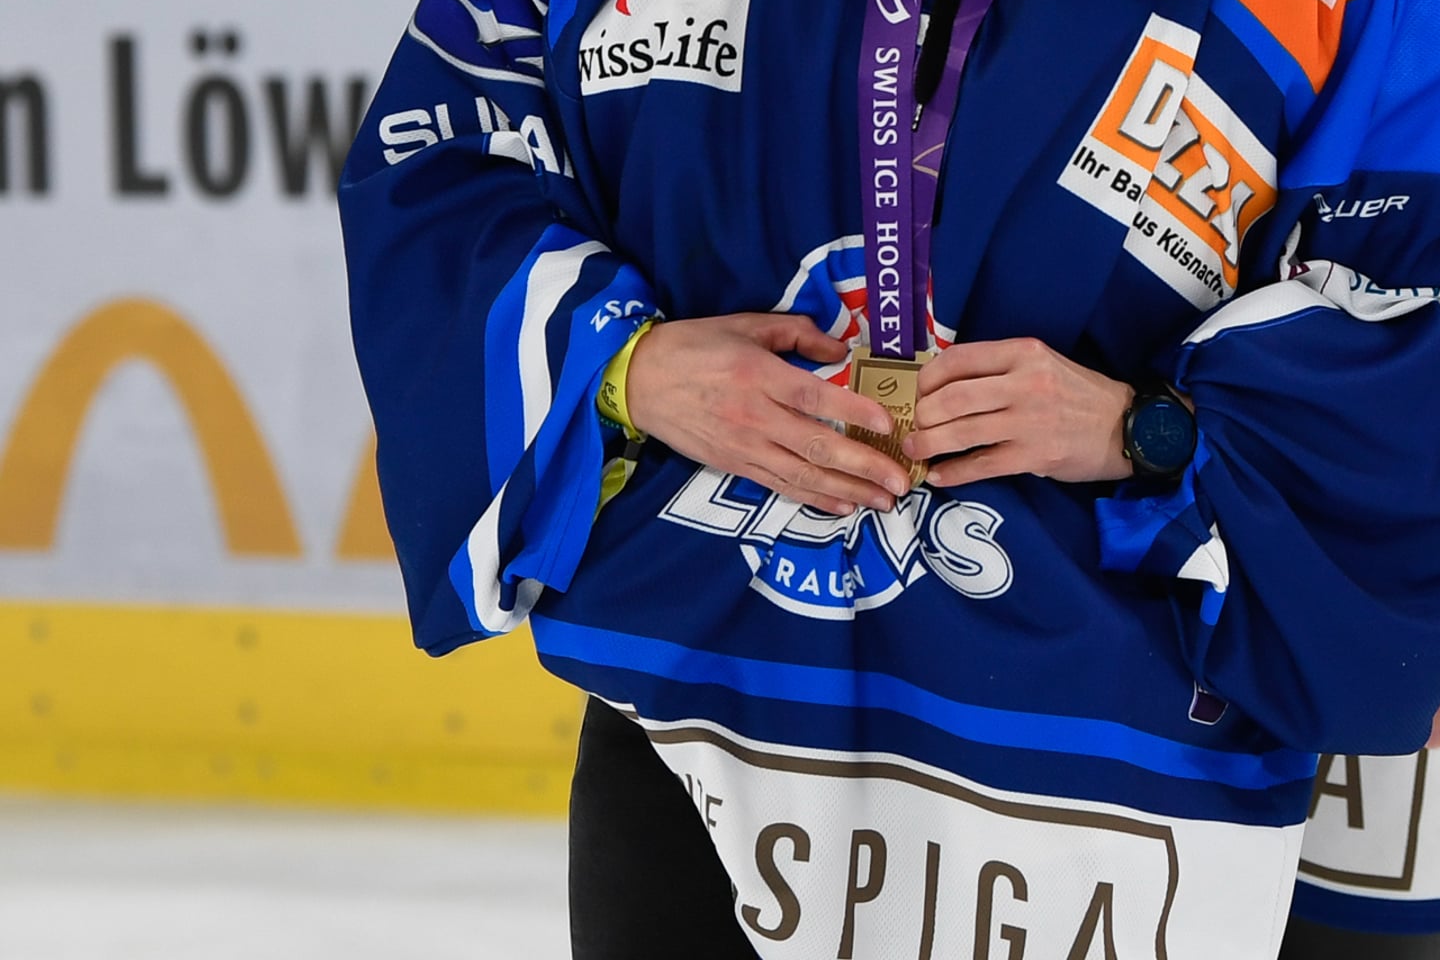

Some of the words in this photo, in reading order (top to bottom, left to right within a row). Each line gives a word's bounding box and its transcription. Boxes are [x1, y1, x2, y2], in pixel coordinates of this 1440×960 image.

[579, 16, 737, 81] wissLife
[872, 46, 900, 146] SWISS
[873, 157, 898, 209] ICE
[1072, 145, 1110, 180] Ihr
[1110, 168, 1147, 205] Ba
[875, 220, 902, 356] HOCKEY
[741, 821, 1116, 960] SPIGA
